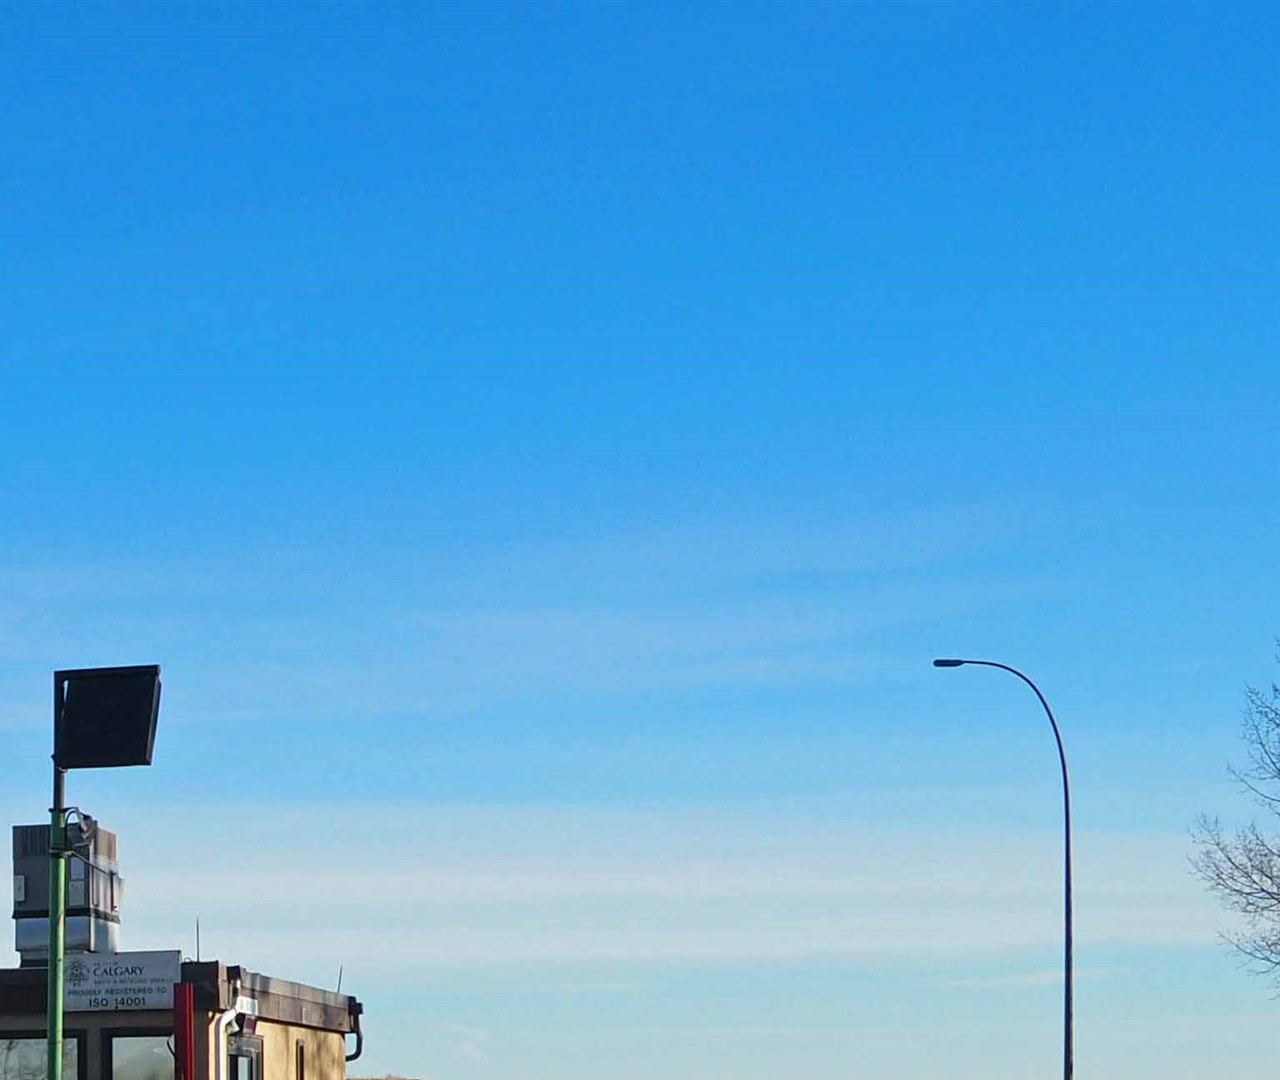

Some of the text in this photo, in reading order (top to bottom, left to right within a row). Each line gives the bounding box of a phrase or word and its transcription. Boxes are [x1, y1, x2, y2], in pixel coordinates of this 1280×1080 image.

[93, 966, 144, 977] CALGARY
[105, 987, 153, 995] REGISTERED
[157, 986, 167, 994] TO
[89, 997, 146, 1007] ISO 14001
